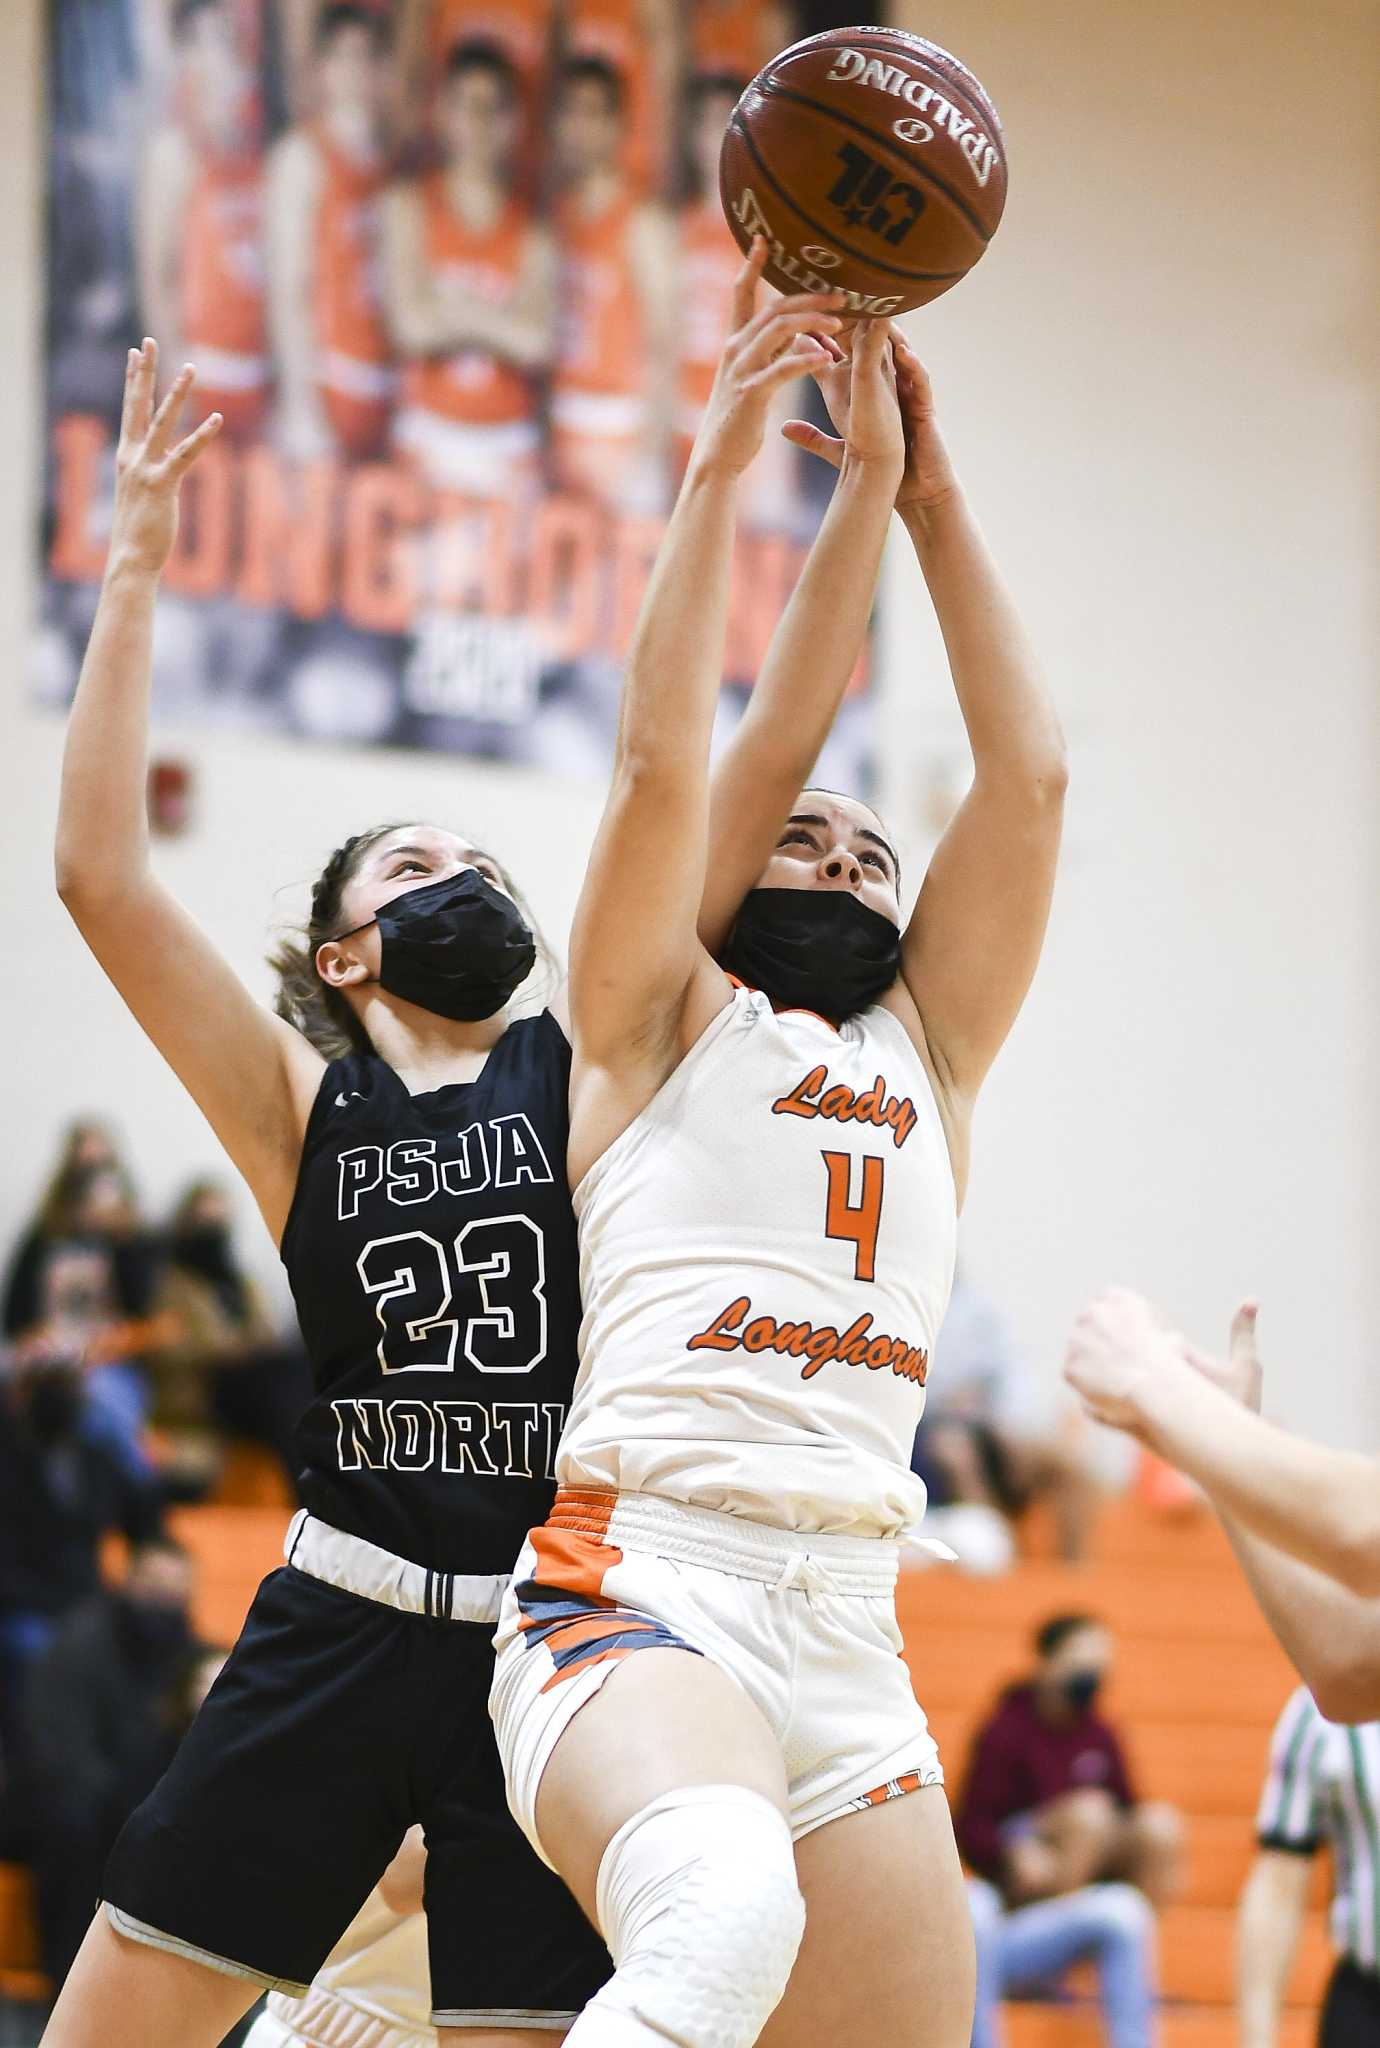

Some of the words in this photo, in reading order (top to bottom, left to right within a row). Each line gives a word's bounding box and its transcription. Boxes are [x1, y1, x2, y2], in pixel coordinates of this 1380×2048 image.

[825, 48, 998, 187] SPALDING
[732, 188, 906, 315] SPALDNG
[338, 1112, 554, 1221] PSJA
[772, 1064, 918, 1148] Lady
[820, 1150, 884, 1282] 4
[356, 1213, 547, 1375] 23
